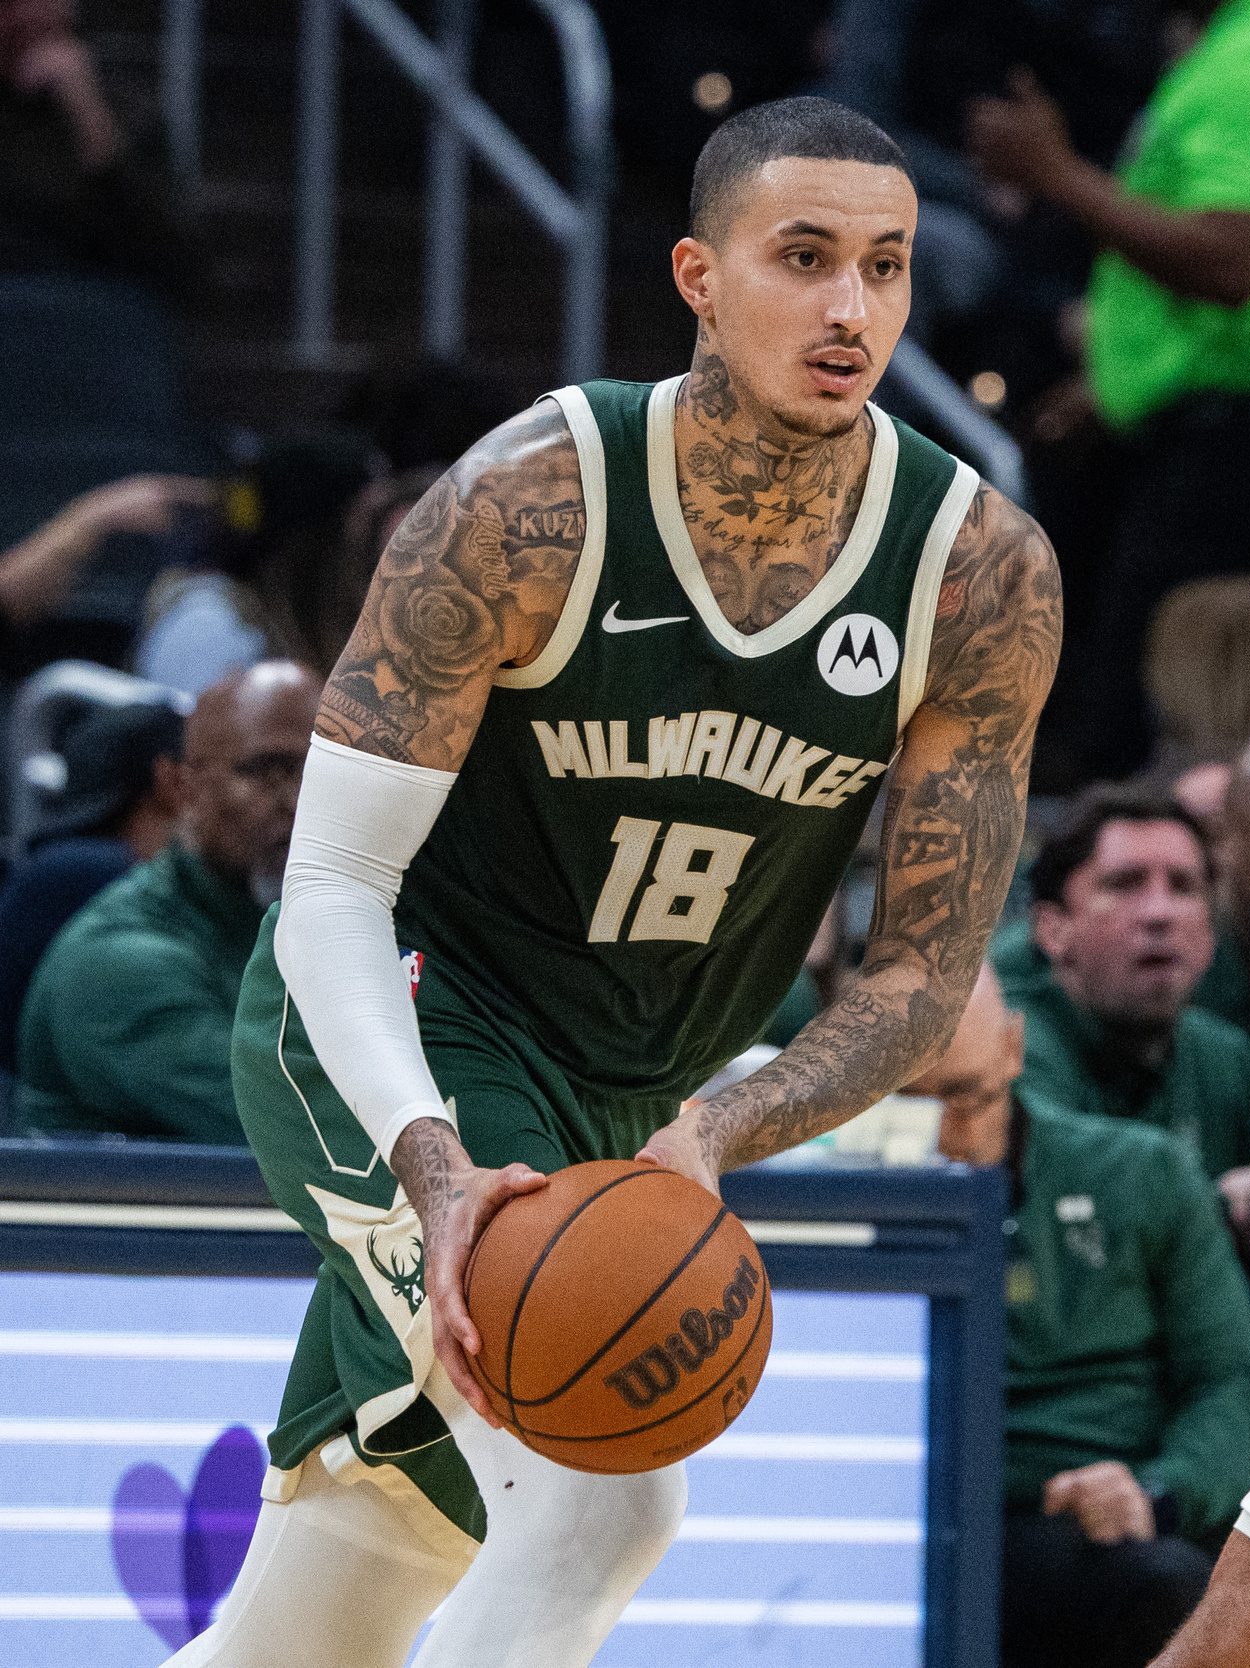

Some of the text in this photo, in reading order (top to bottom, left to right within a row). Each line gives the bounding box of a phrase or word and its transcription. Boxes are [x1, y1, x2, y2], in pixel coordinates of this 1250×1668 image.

[531, 711, 889, 809] MILWAUKEE
[587, 815, 757, 944] 18
[602, 1254, 760, 1411] Wilson
